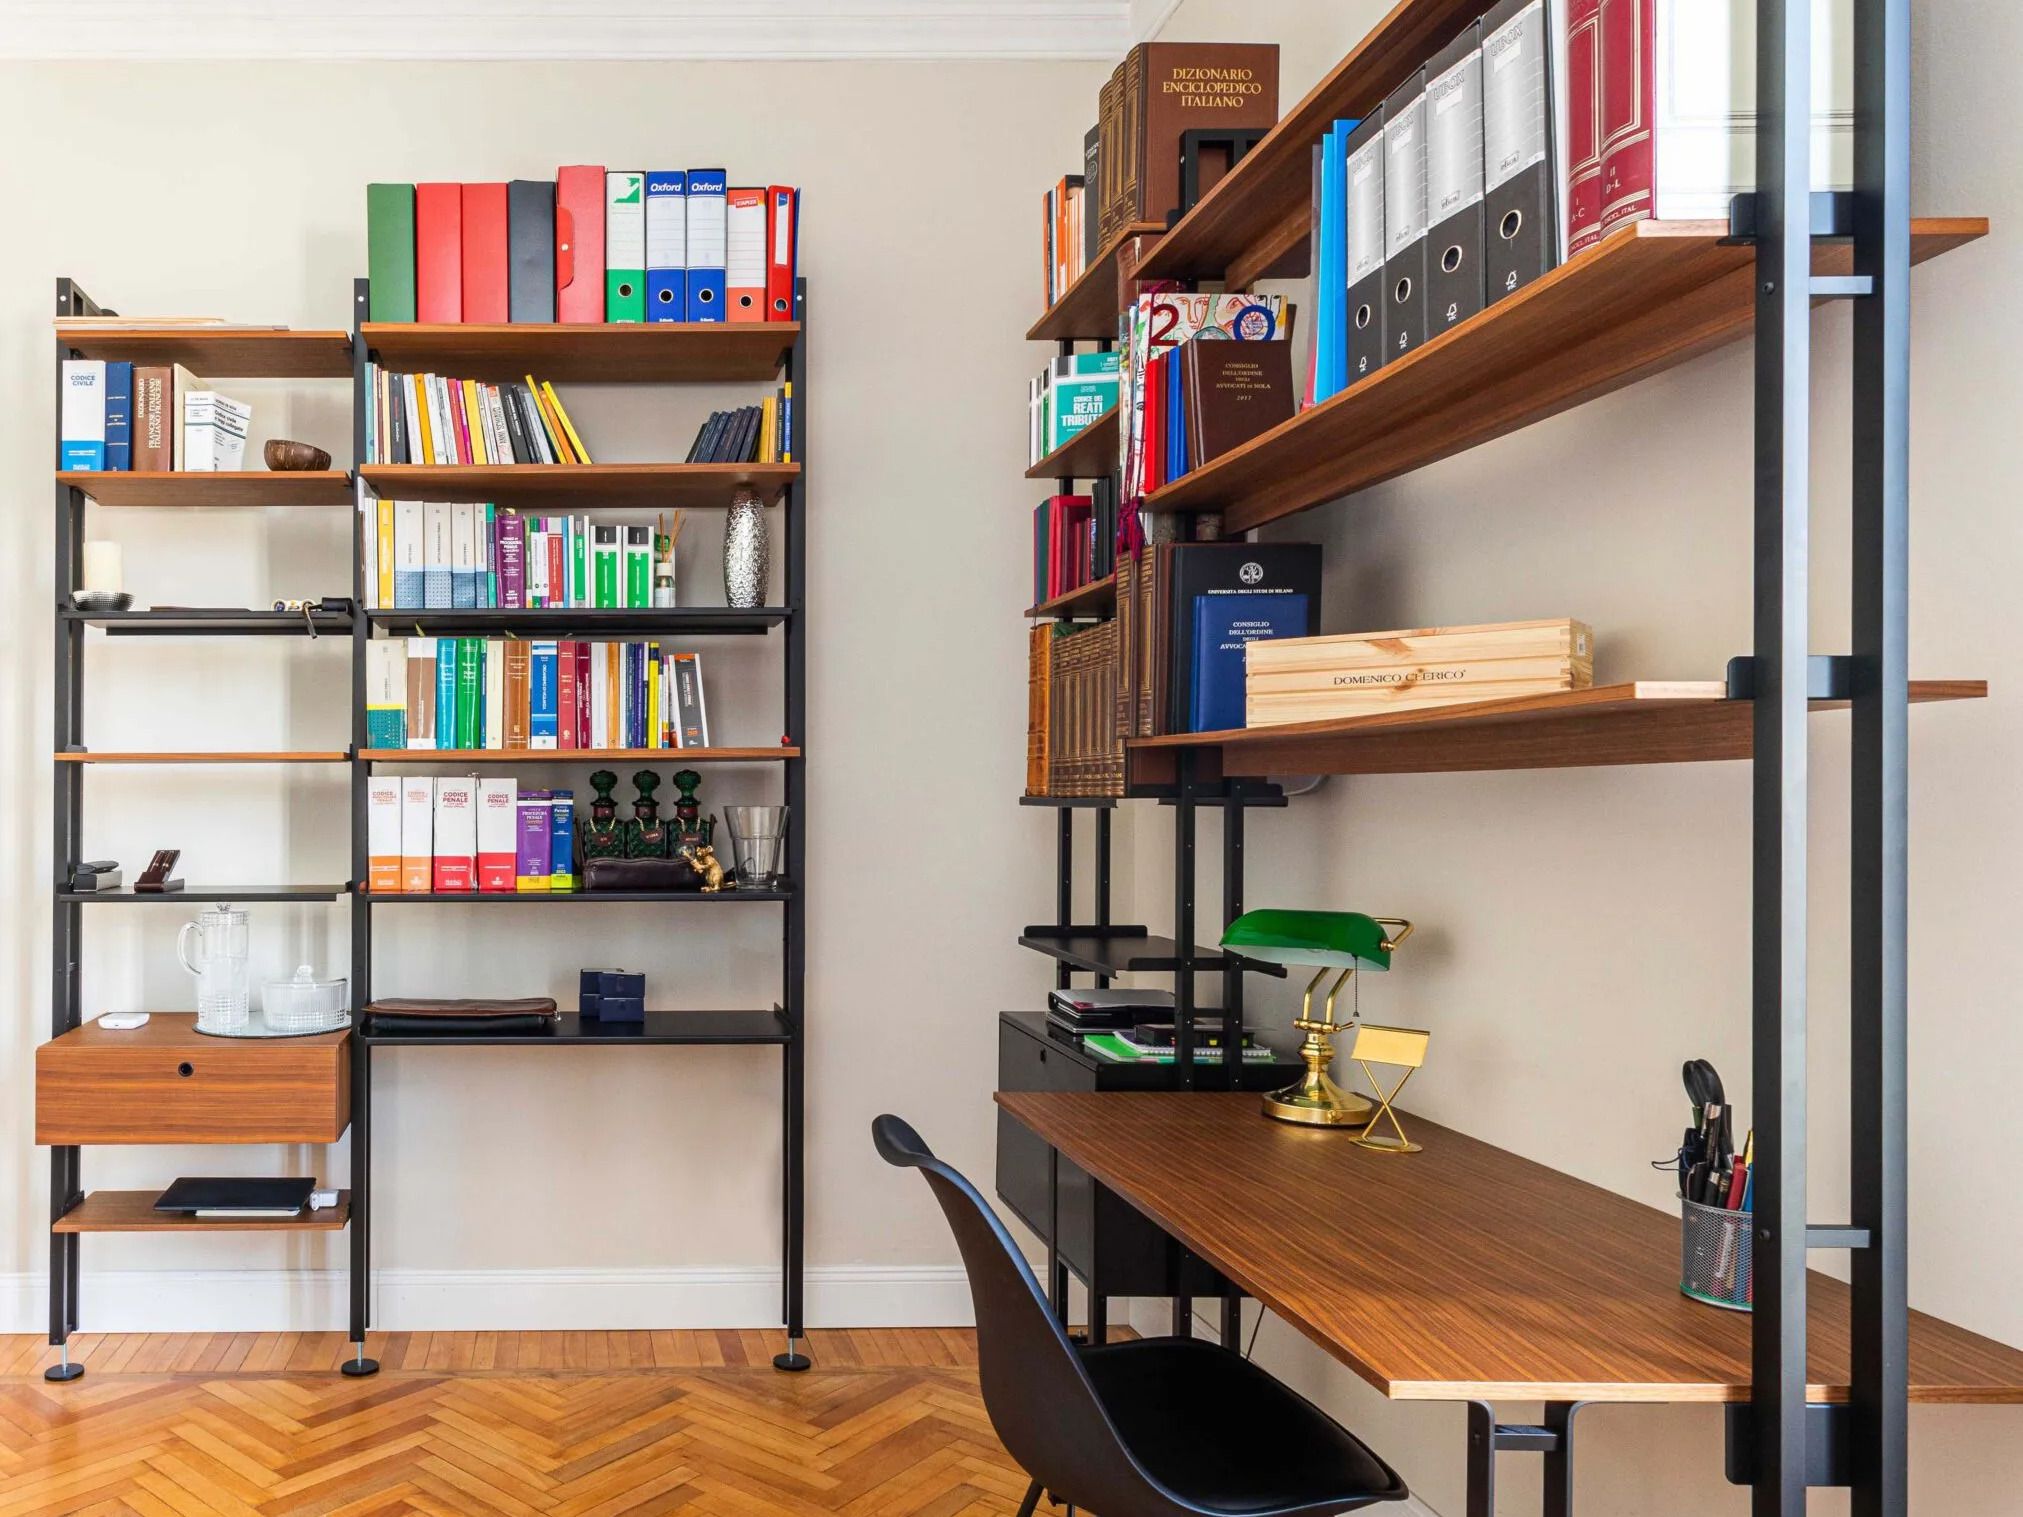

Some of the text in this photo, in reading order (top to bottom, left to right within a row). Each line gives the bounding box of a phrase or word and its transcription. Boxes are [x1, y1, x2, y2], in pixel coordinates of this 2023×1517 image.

[1173, 68, 1252, 80] DIZIONARIO
[1163, 81, 1262, 95] ENCICLOPEDICO
[1182, 95, 1244, 108] ITALIANO
[650, 183, 682, 192] Oxford
[691, 182, 722, 192] Oxford
[1149, 303, 1180, 347] 2
[1073, 402, 1103, 414] REATI
[1061, 413, 1102, 427] TRIBUT
[1334, 671, 1464, 685] DOMENICO CLERICO
